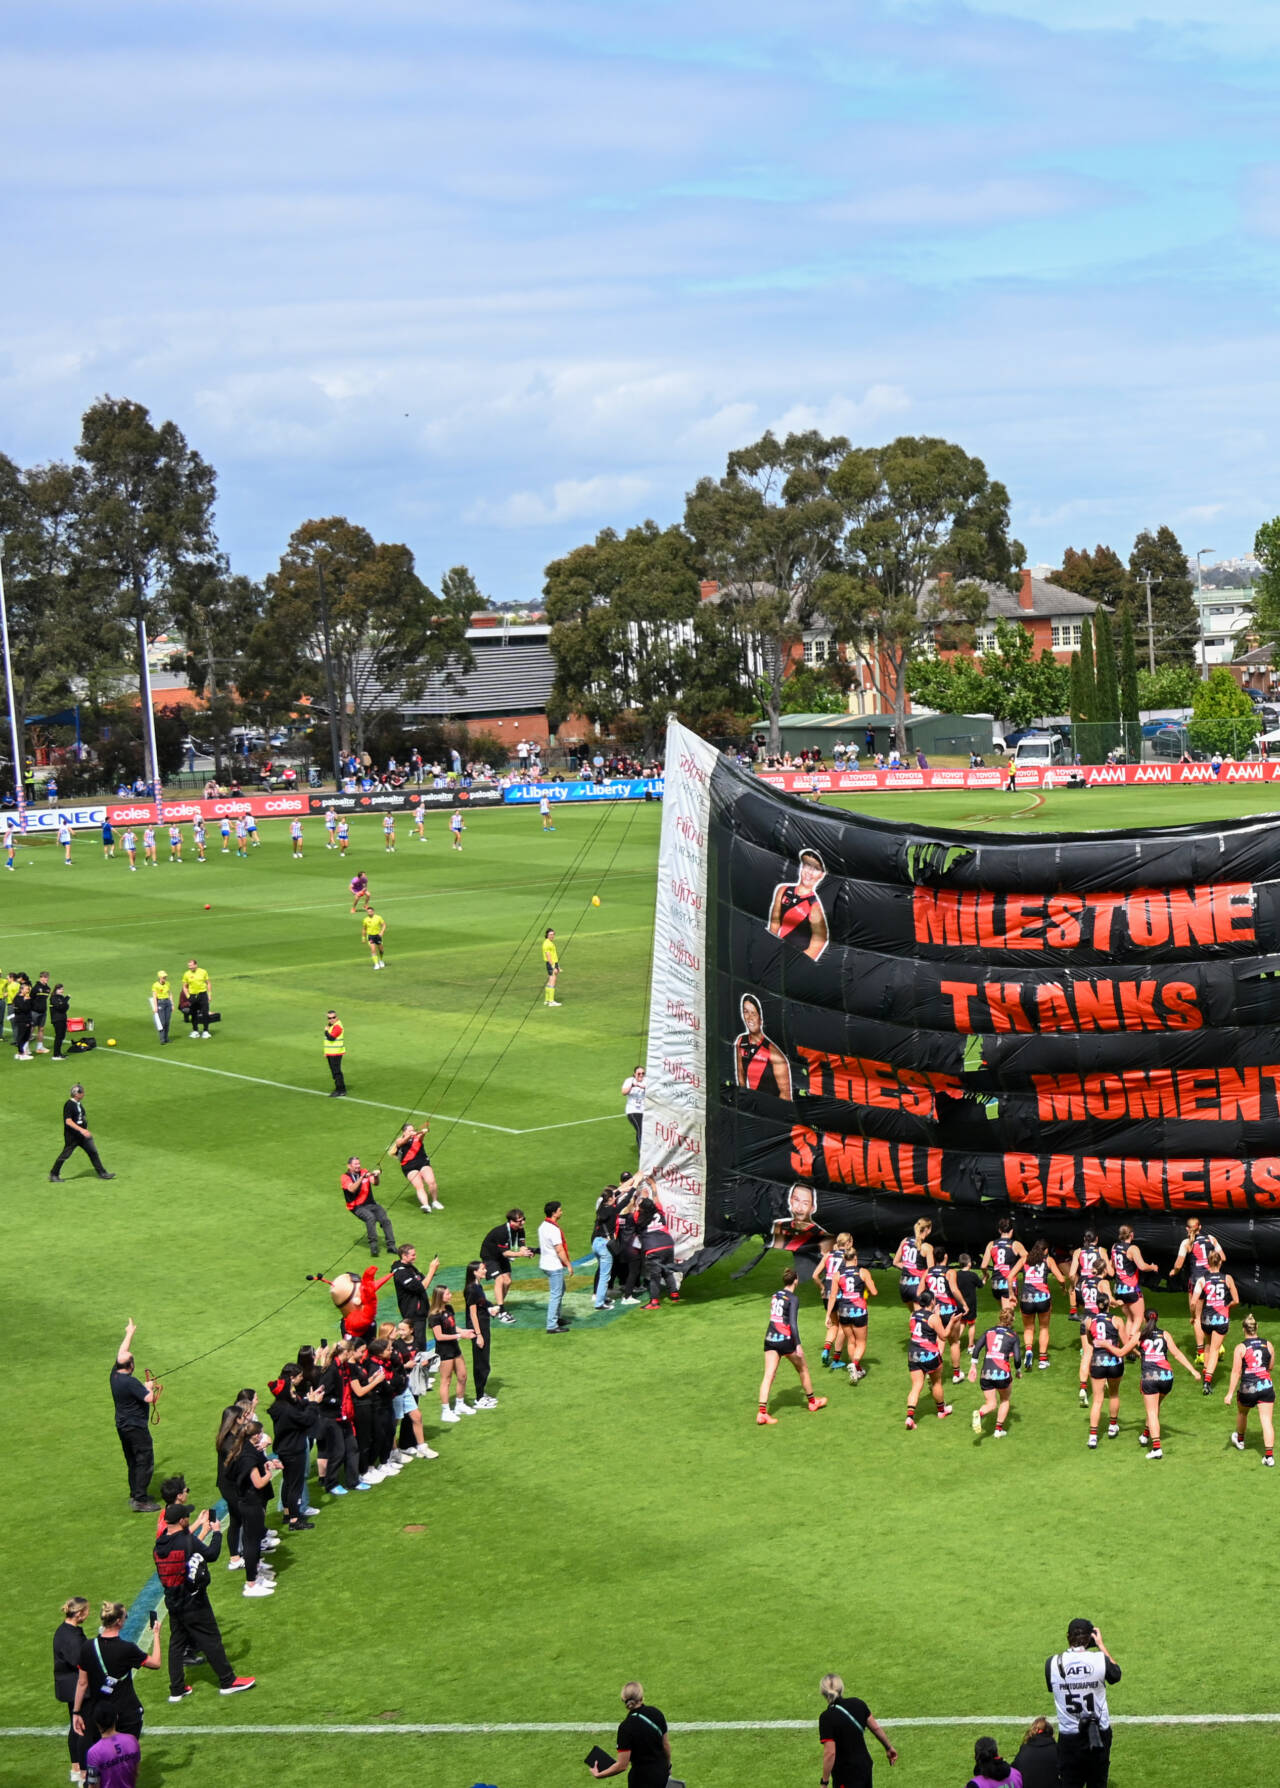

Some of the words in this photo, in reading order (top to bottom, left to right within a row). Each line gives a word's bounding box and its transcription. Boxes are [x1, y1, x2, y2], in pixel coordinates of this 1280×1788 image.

[1089, 768, 1126, 782] AAMI
[1134, 766, 1171, 781] AAMI
[1180, 766, 1217, 780] AAM
[1227, 765, 1263, 779] AAMI
[522, 786, 568, 800] Liberty
[586, 784, 631, 797] Liberty
[114, 807, 150, 820] coles
[164, 804, 200, 817] coles
[215, 802, 251, 814] coles
[265, 799, 302, 812] coles
[58, 811, 104, 826] NEC
[913, 882, 1255, 950] MILESTONE
[669, 939, 700, 971] FUJITSU
[667, 1000, 700, 1031] FUJITSU
[940, 980, 1204, 1034] THANKS
[664, 1057, 700, 1089] FUJITSU
[656, 1121, 701, 1154] FUJITSU
[790, 1124, 952, 1202] SMALL
[666, 1204, 700, 1238] JITSU
[902, 1246, 917, 1263] 30
[997, 1249, 1006, 1264] 8
[1199, 1244, 1207, 1259] 1
[1082, 1253, 1097, 1268] 12
[846, 1277, 854, 1292] 6
[928, 1276, 946, 1294] 26
[1206, 1284, 1225, 1301] 25
[1083, 1288, 1097, 1303] 28
[771, 1299, 784, 1317] 36
[913, 1322, 922, 1337] 4
[1096, 1324, 1106, 1340] 9
[993, 1335, 1004, 1353] 5
[1144, 1339, 1164, 1356] 22
[1252, 1350, 1263, 1368] 3
[1067, 1666, 1091, 1676] AFL
[1065, 1692, 1095, 1713] 51
[114, 1744, 122, 1754] 5
